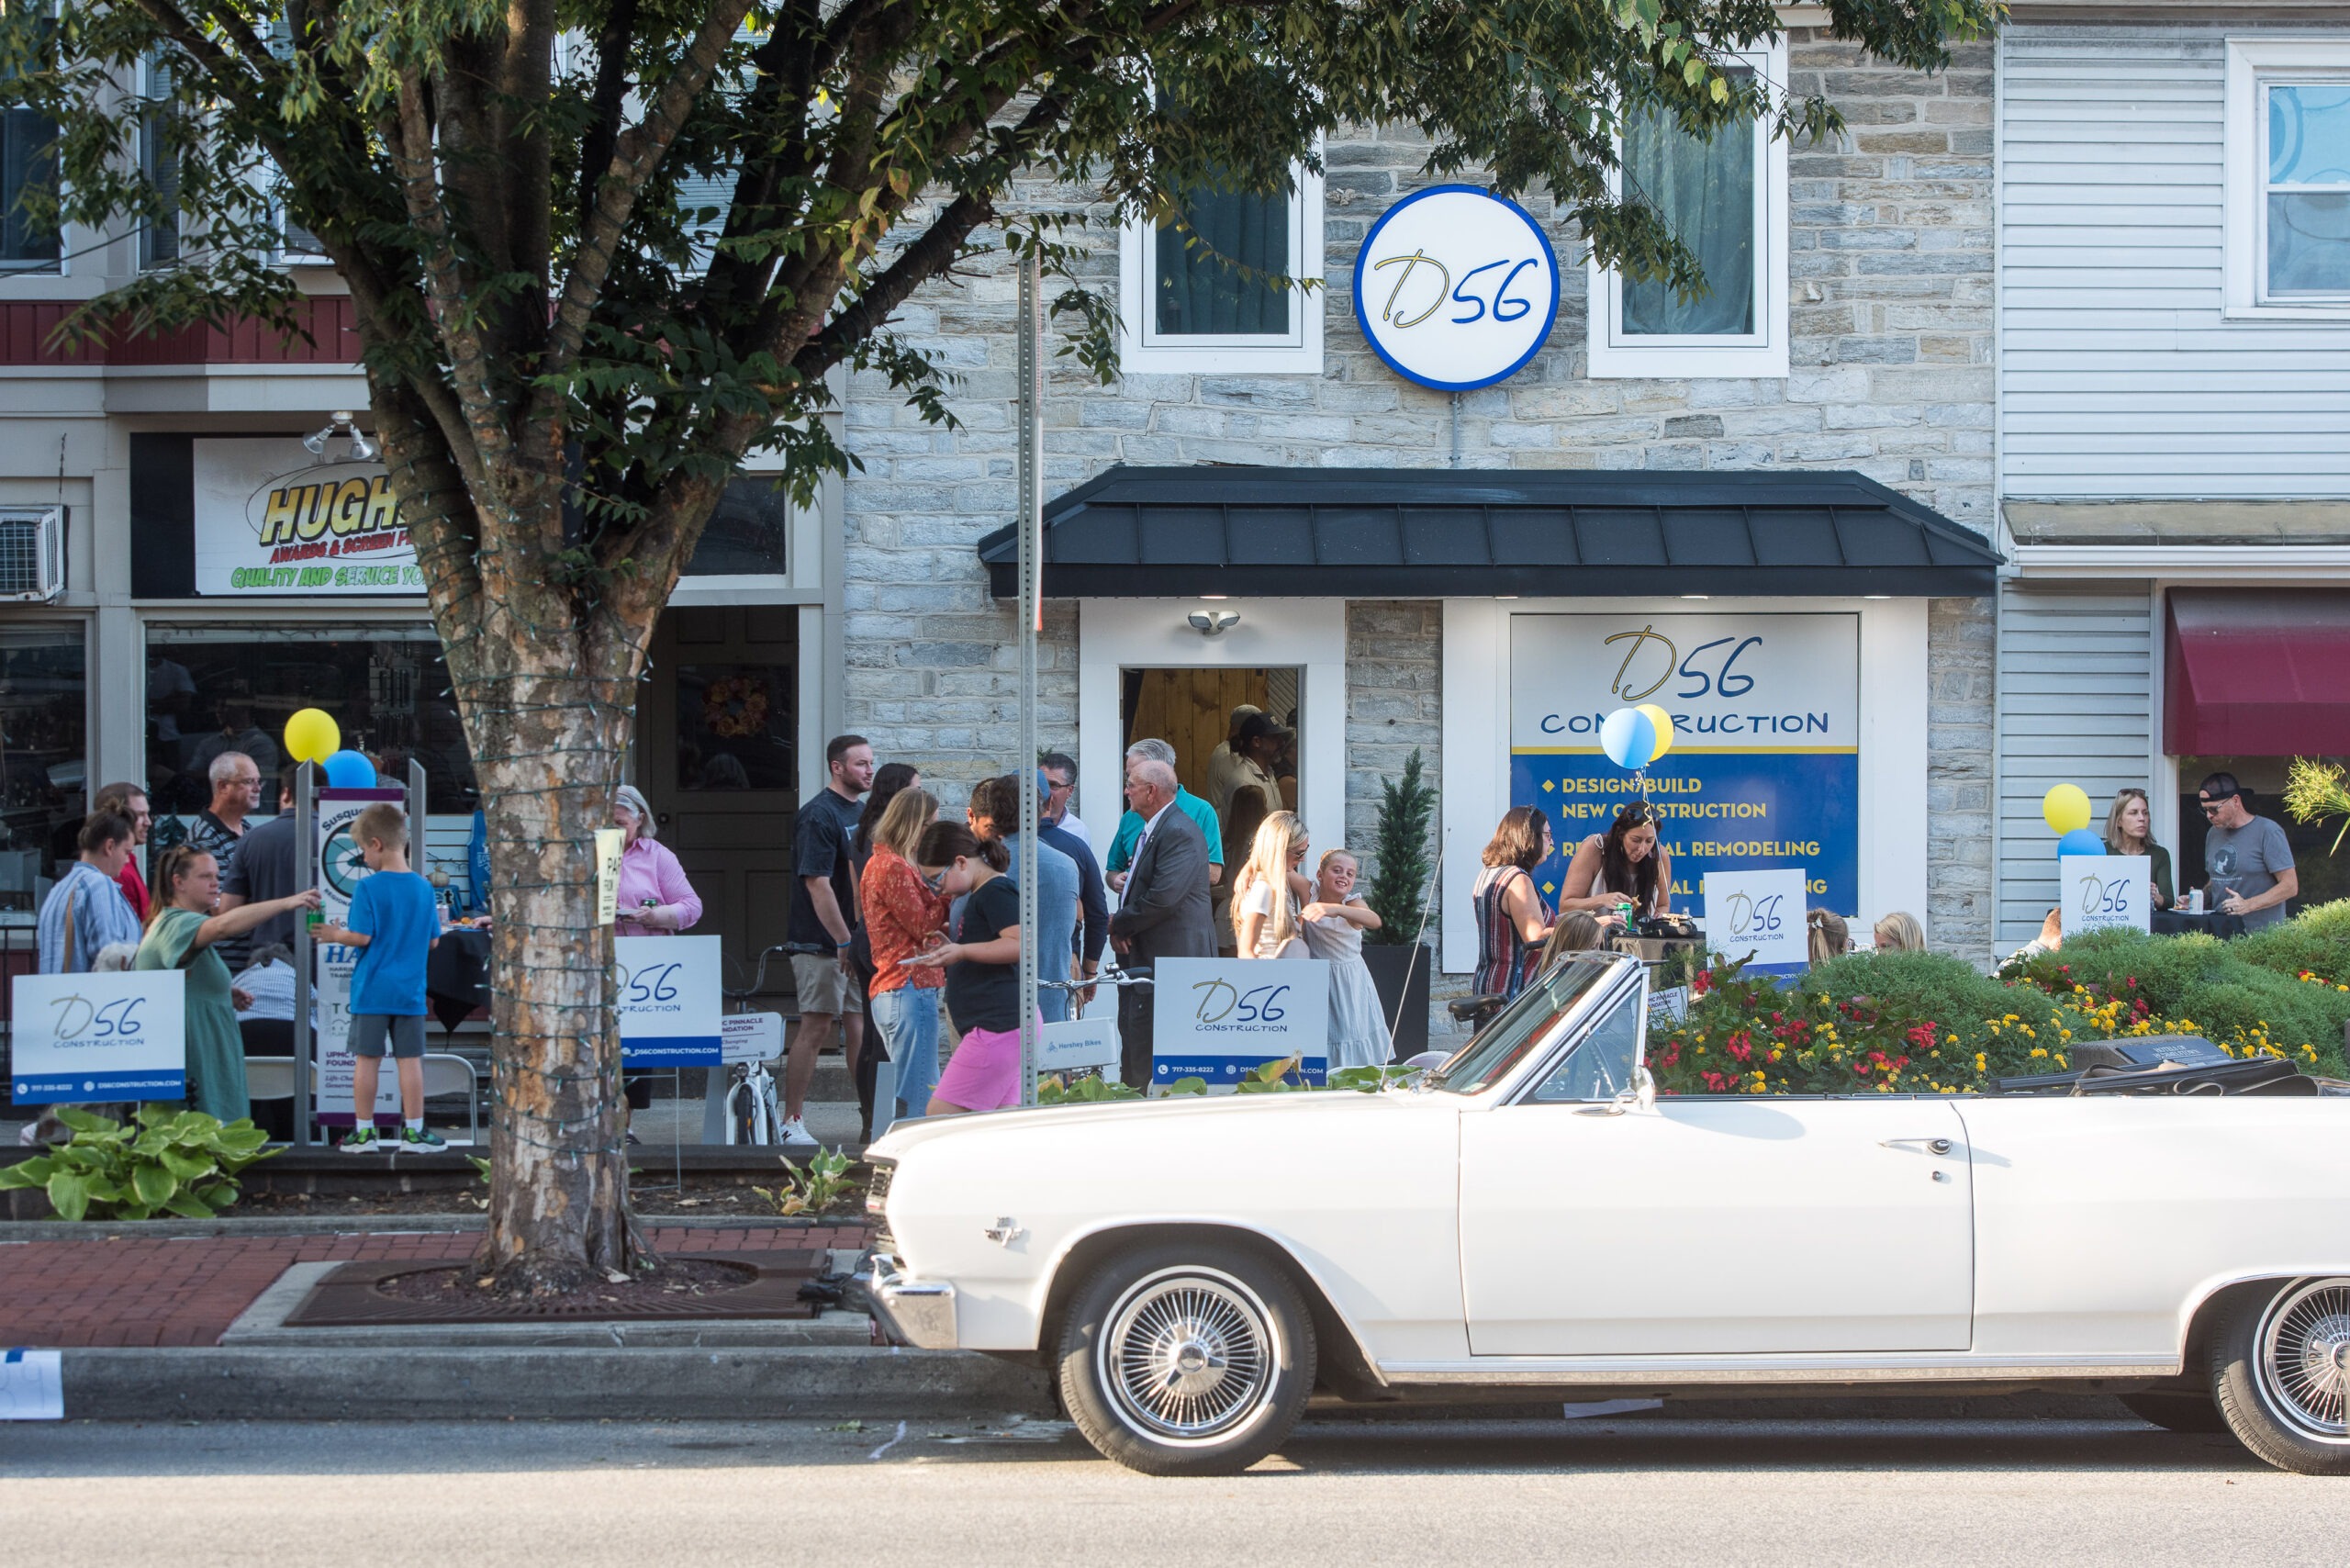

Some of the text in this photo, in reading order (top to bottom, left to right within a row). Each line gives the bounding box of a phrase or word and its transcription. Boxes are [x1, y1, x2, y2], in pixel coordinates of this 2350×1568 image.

[1374, 249, 1539, 329] D56
[259, 475, 409, 547] HUGH
[269, 541, 328, 565] AWARDS
[329, 539, 341, 556] &
[342, 532, 396, 554] SCREEN
[231, 566, 300, 588] QUALITY
[298, 566, 333, 588] AND
[335, 566, 400, 587] SERVICE
[1604, 624, 1762, 700] D56
[1540, 712, 1829, 734] CORUCTION
[1562, 802, 1767, 819] NEW CSTRUCTION
[1692, 841, 1820, 856] REMODELING
[2080, 873, 2131, 914] D56
[1726, 890, 1784, 935] D56
[1729, 934, 1785, 943] CONSTRUCTION
[615, 963, 682, 1002] 56
[50, 992, 146, 1040] D56
[1192, 978, 1291, 1024] D56
[53, 1038, 145, 1048] CONSTRUCTION
[1195, 1024, 1288, 1033] CONSTRUCTION
